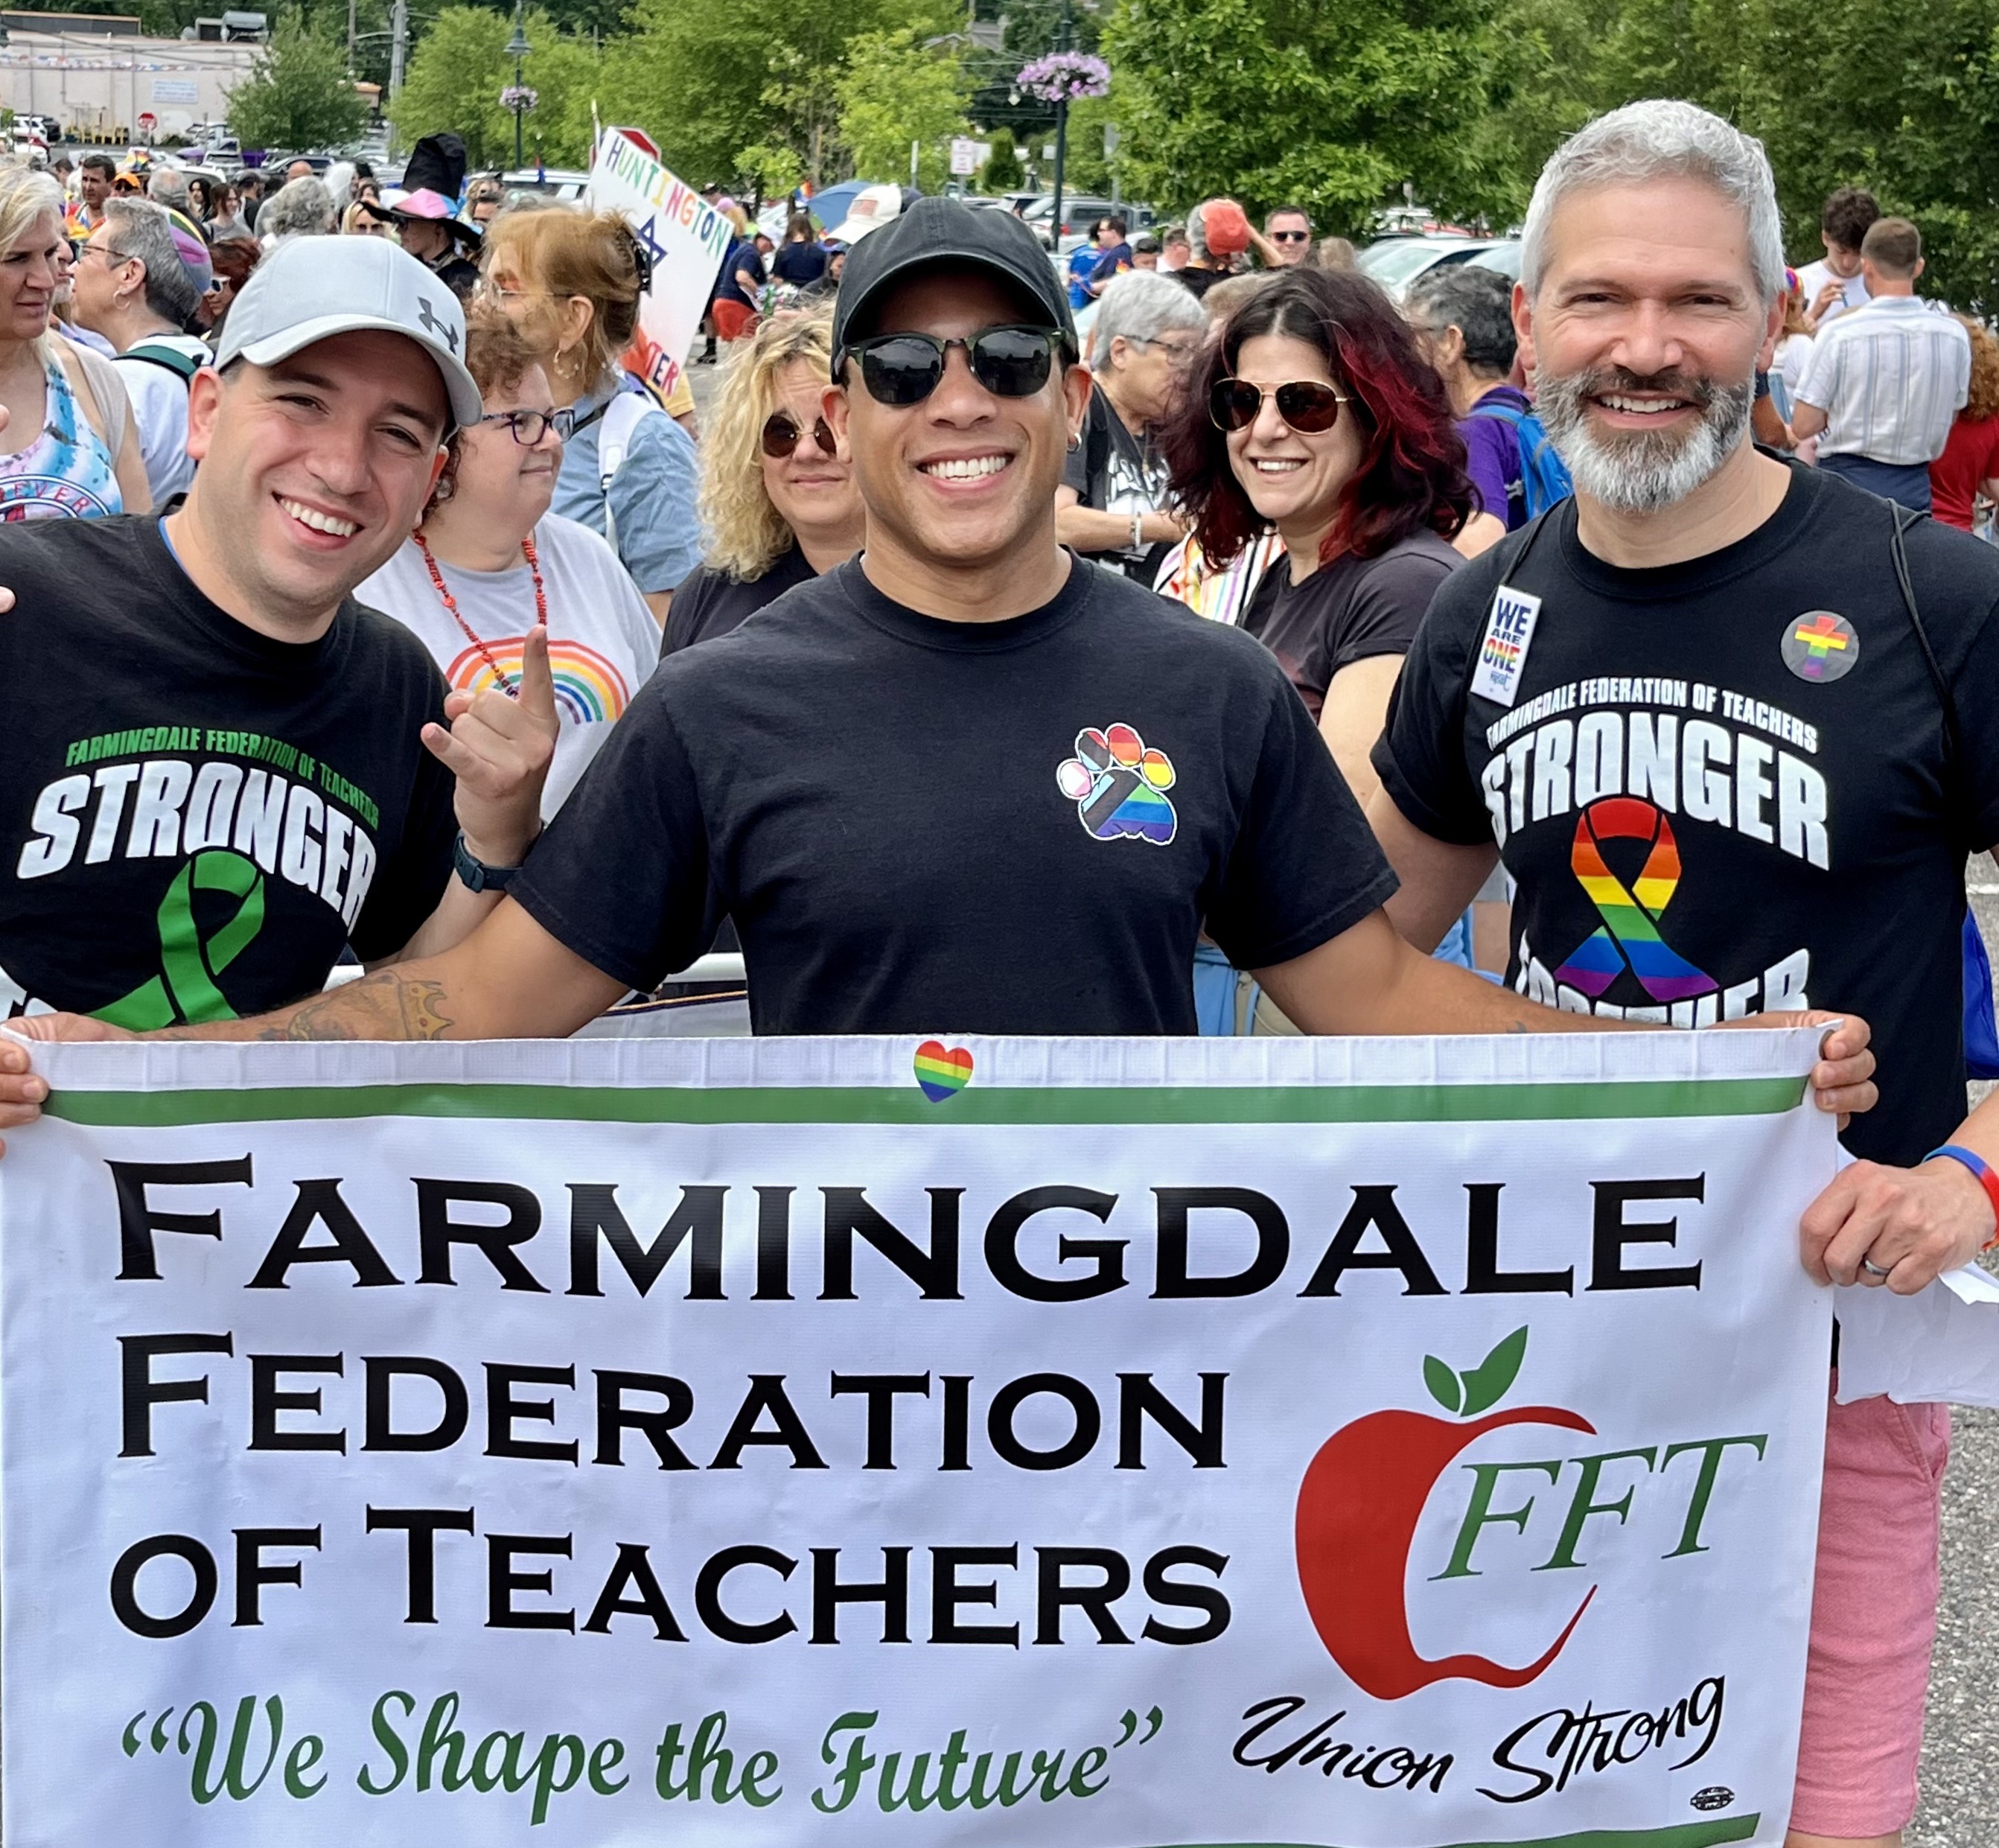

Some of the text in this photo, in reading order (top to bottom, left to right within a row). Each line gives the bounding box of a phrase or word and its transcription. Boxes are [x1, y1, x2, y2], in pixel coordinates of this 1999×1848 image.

[605, 136, 730, 261] HUNTINGTON
[645, 341, 679, 398] TER
[1483, 638, 1520, 674] ONE
[1491, 628, 1521, 646] ARE
[1496, 598, 1531, 637] WE
[66, 726, 379, 831] FARMINGDALE FEDERATION OF TEACHERS
[1486, 677, 1818, 753] FARMINGDALE FEDERATION OF TEACHERS
[16, 759, 377, 937] STRONGER
[1481, 711, 1829, 872] STRONGER
[103, 1152, 1706, 1303] FARMINGDALE
[116, 1331, 1230, 1471] FEDERATION
[1426, 1434, 1768, 1581] FFT
[110, 1503, 1231, 1651] OF TEACHERS
[357, 1690, 630, 1826] Shape
[656, 1710, 782, 1807] the
[1232, 1675, 1725, 1803] Union Strong
